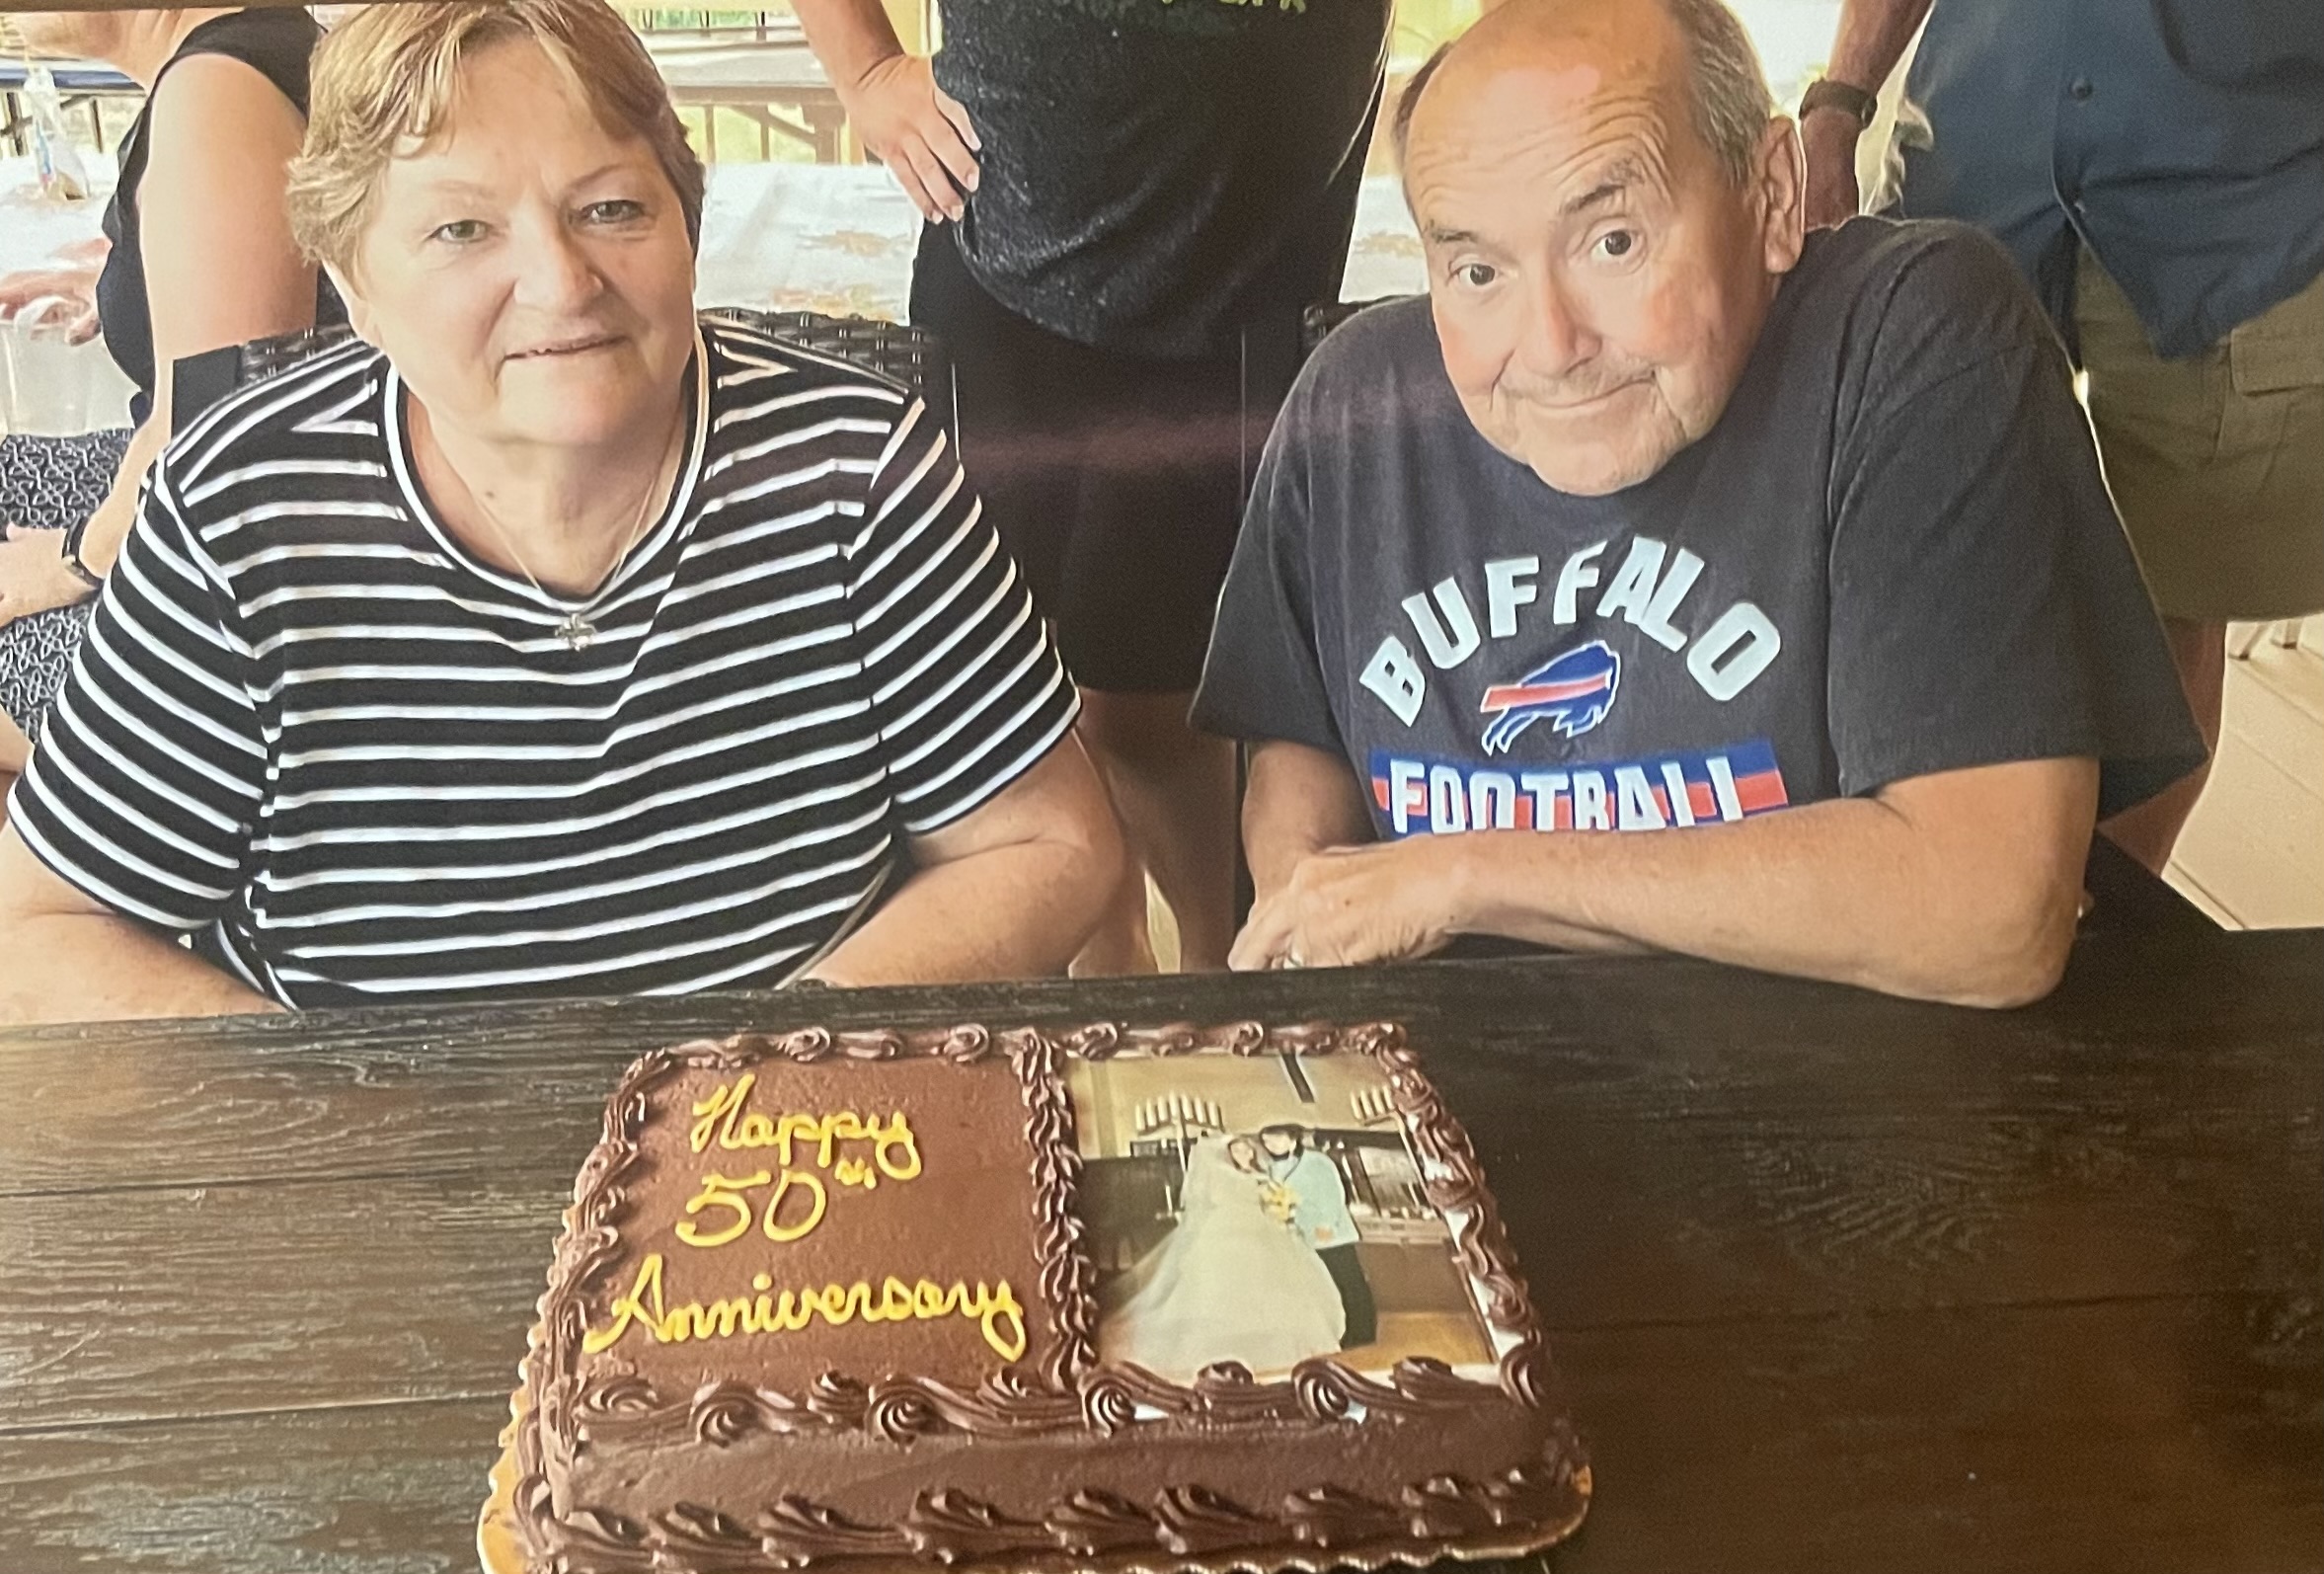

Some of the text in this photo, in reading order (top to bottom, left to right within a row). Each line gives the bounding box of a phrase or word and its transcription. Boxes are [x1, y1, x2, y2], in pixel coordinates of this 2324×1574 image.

[1358, 535, 1781, 727] BUFFALO
[690, 1073, 922, 1180] Happy
[582, 1253, 1028, 1363] Anniversary
